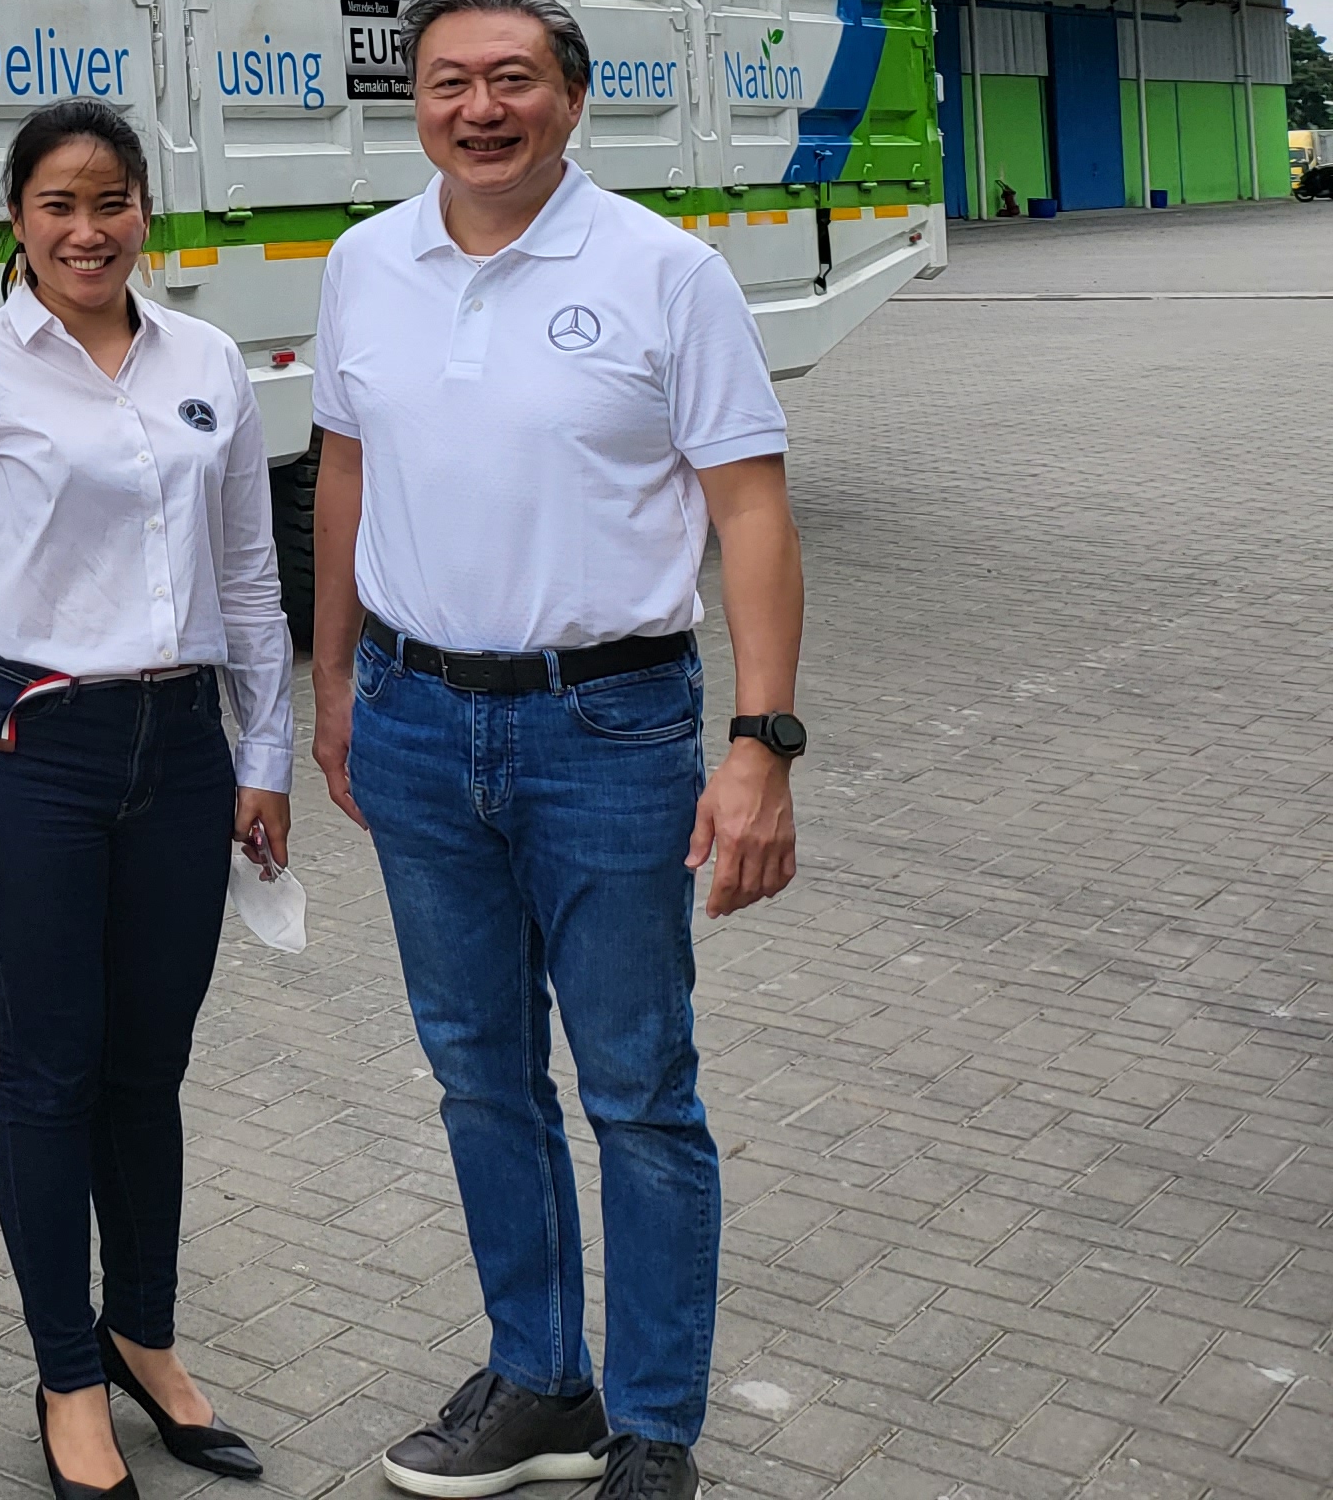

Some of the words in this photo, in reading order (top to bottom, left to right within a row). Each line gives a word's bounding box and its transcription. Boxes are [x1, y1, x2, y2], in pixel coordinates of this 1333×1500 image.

[350, 28, 402, 65] EUR
[217, 34, 325, 110] using
[588, 59, 677, 98] reener
[724, 50, 803, 100] Nation
[354, 79, 389, 93] Semakin
